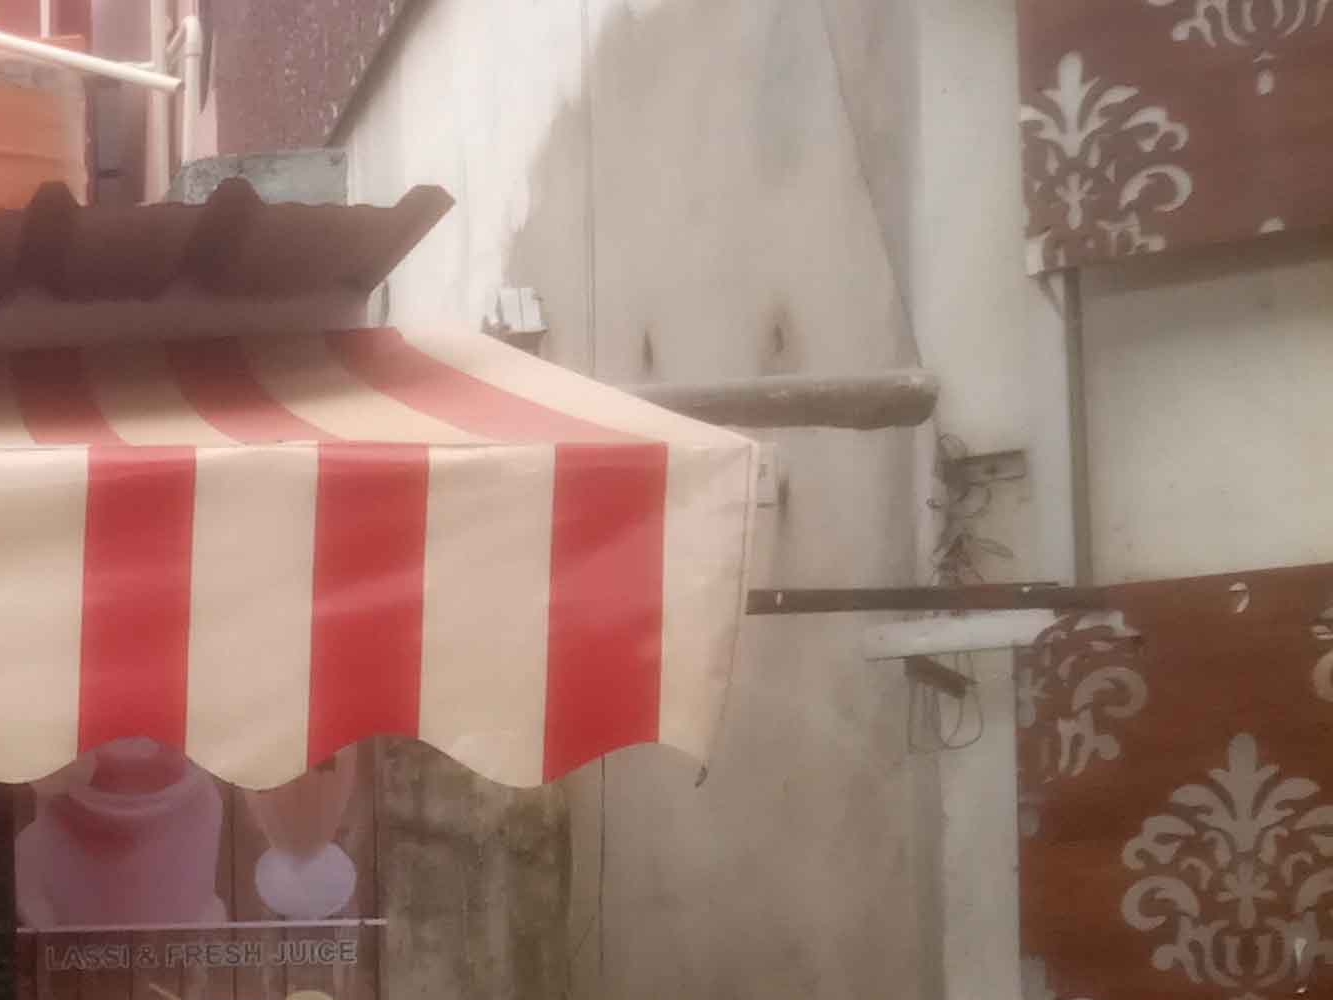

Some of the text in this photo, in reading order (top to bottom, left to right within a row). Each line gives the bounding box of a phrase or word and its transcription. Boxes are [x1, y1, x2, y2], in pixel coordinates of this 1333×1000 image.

[46, 939, 358, 969] LASSI & FRESH JUICE
